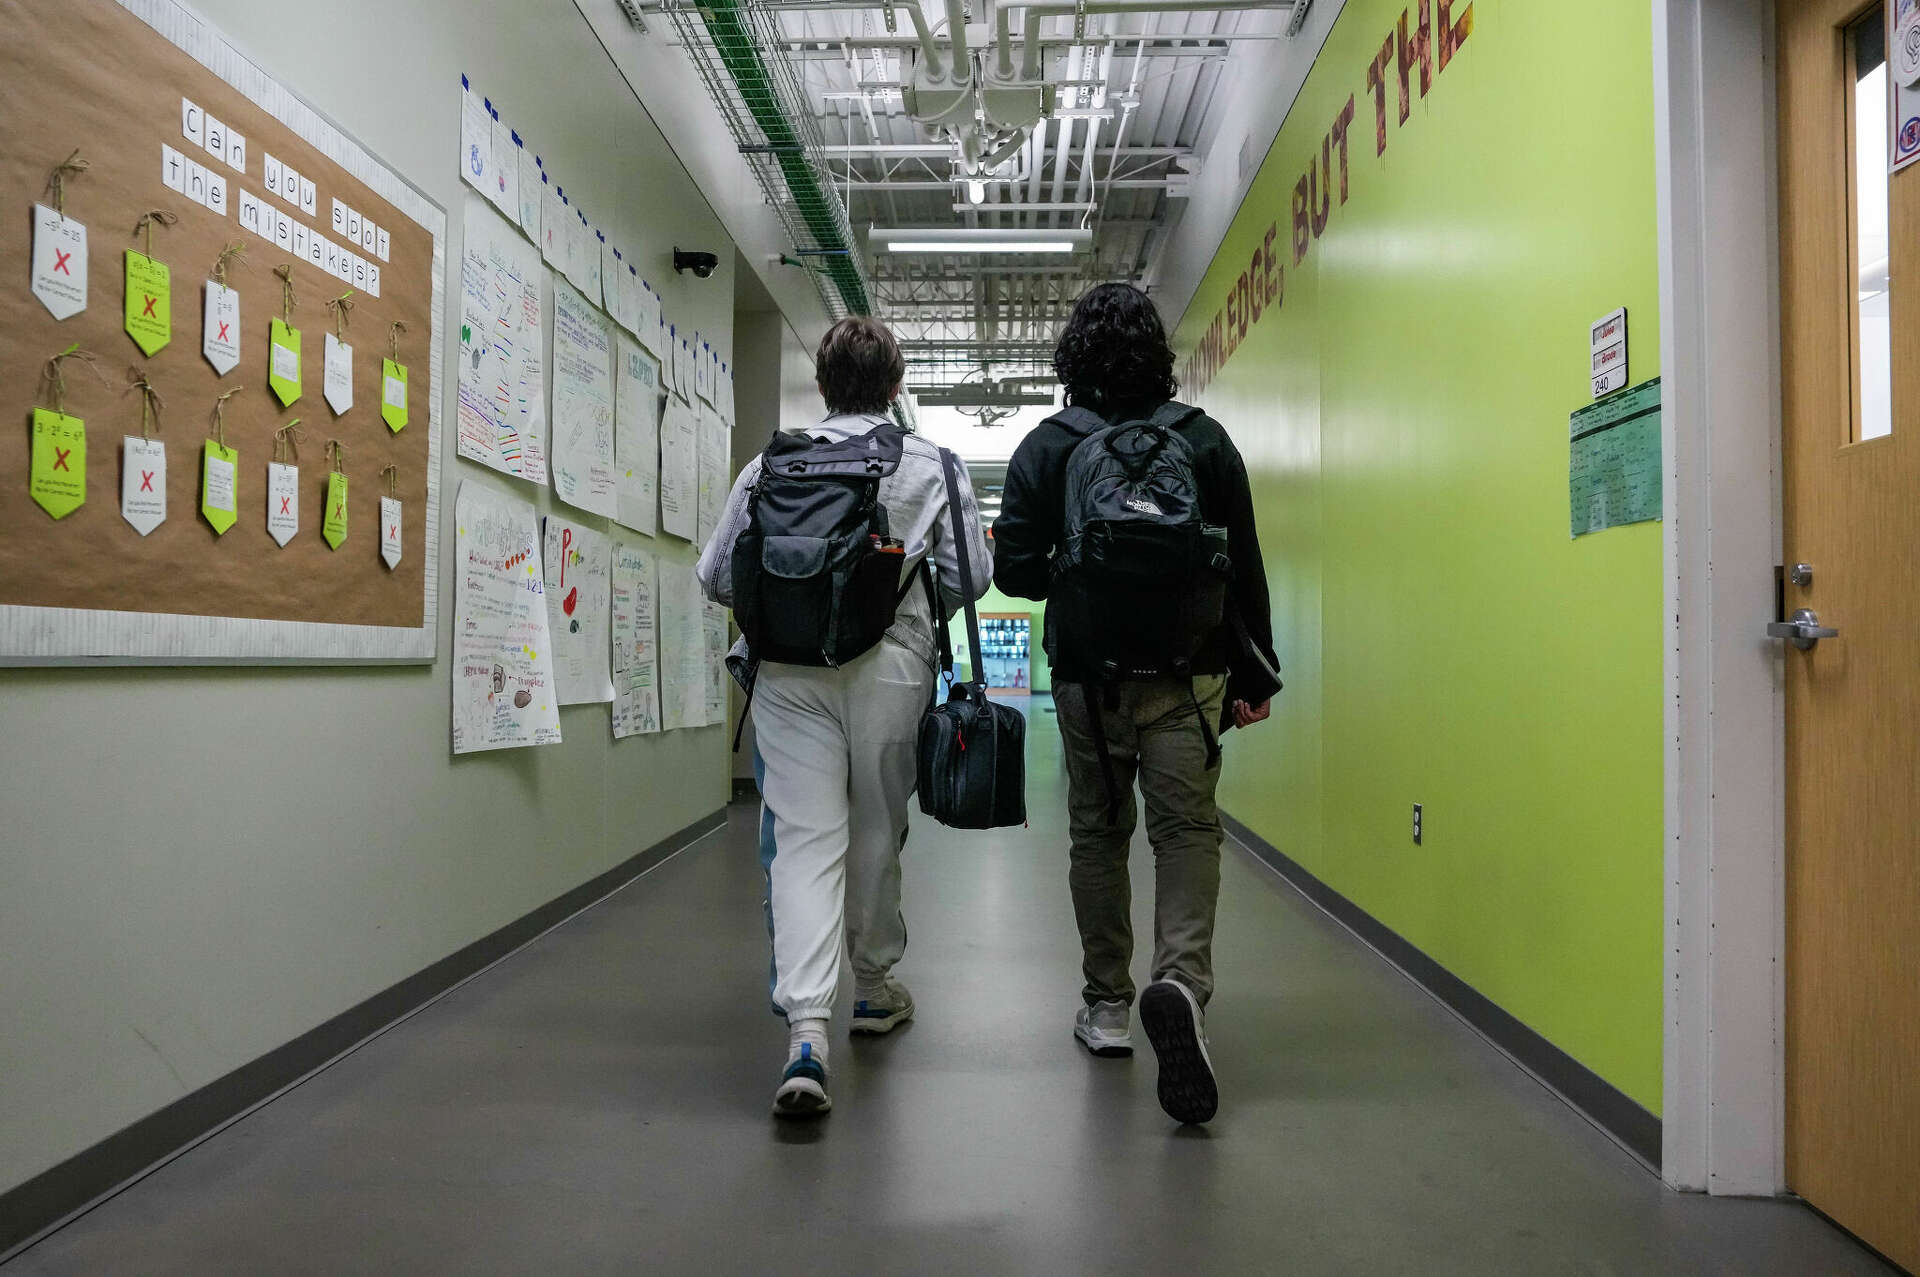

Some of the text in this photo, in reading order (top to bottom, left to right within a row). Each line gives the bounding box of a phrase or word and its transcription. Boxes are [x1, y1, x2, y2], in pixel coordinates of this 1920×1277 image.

[169, 155, 222, 204] the
[243, 201, 377, 288] mistakes?
[186, 107, 386, 255] Can you spot
[1292, 92, 1355, 270] BUT
[1595, 377, 1609, 395] 240
